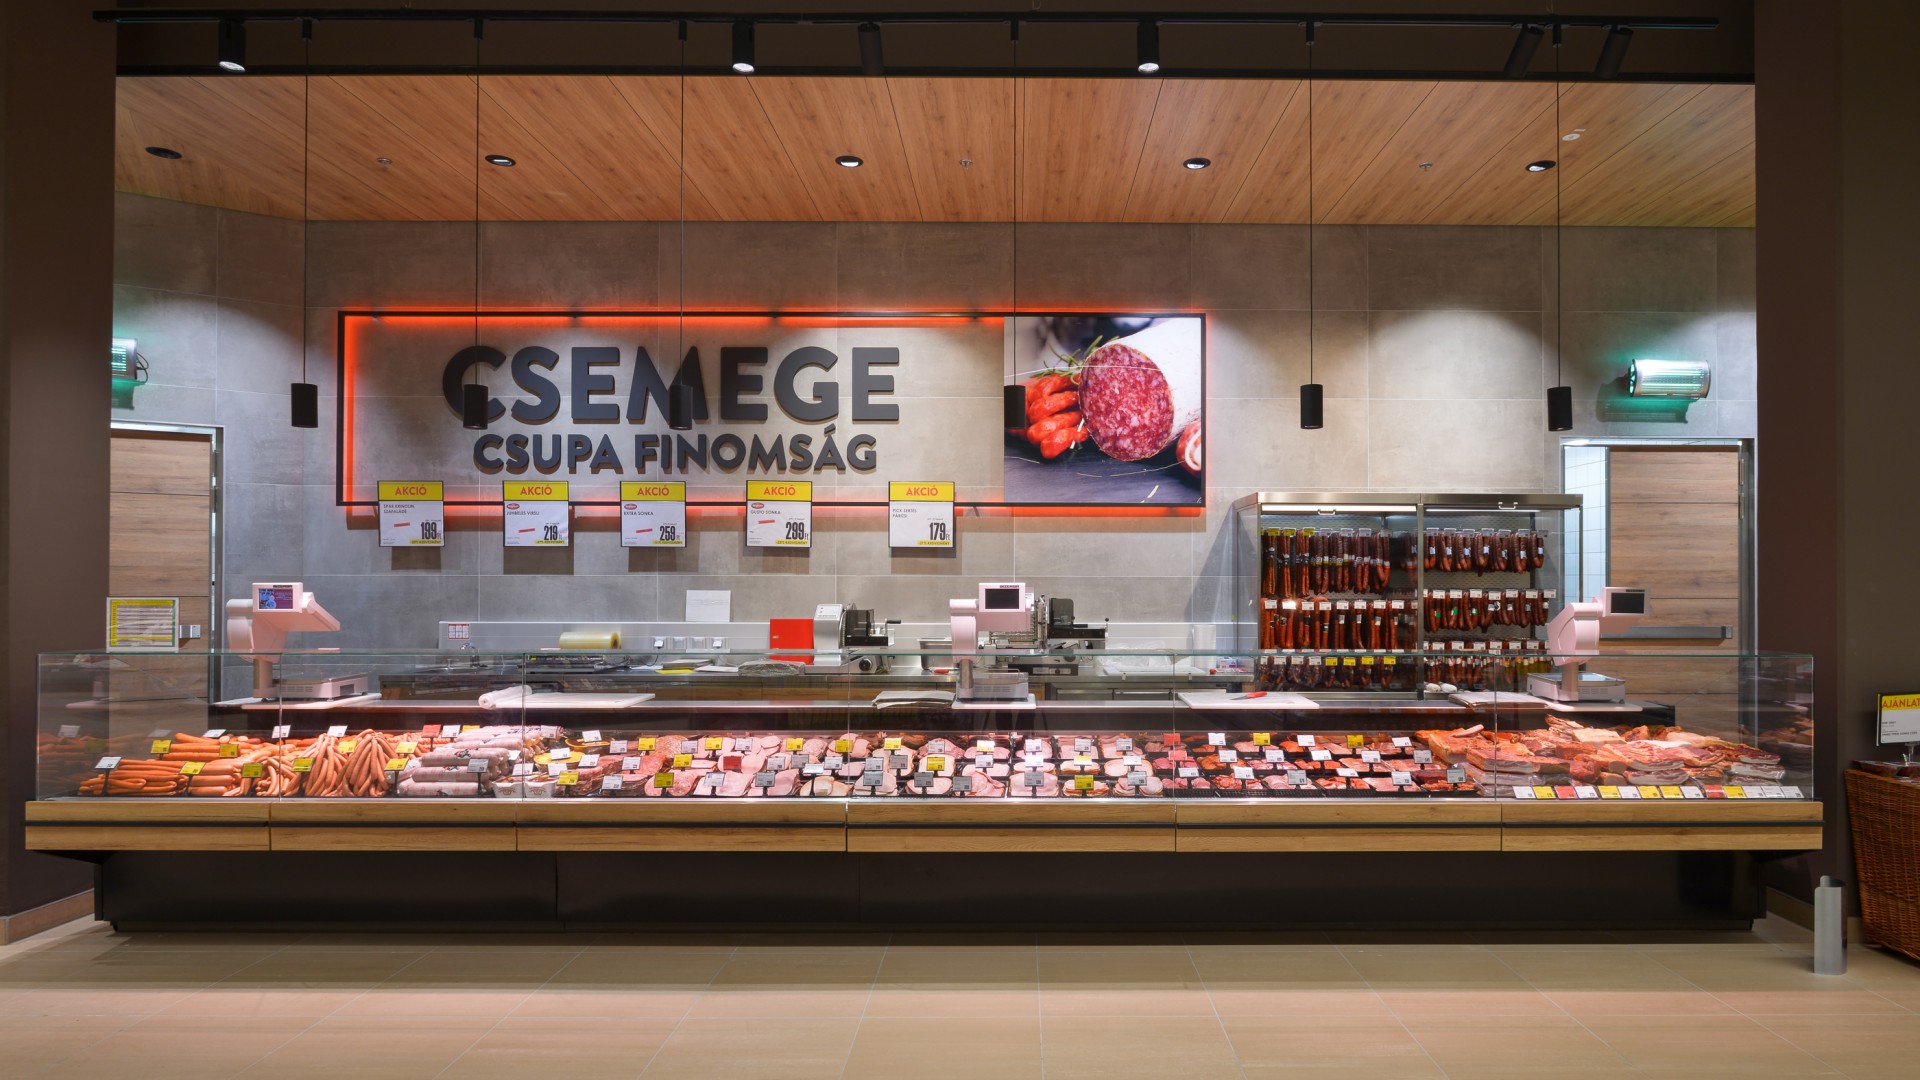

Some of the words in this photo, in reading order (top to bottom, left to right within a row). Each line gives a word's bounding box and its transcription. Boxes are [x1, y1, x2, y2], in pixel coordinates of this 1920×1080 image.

[442, 345, 900, 422] CSEMEGE
[473, 433, 622, 470] CSUPA
[634, 424, 877, 470] FINOMSÁG
[395, 484, 427, 496] AKCIÓ
[520, 484, 552, 496] AKCIÓ
[637, 485, 670, 496] AKCIÓ
[763, 484, 796, 496] AKCIÓ
[906, 485, 938, 496] AKCIÓ
[421, 521, 437, 540] 199
[543, 525, 558, 541] 219
[659, 525, 676, 542] 259
[785, 521, 805, 540] 299
[929, 522, 946, 541] 179
